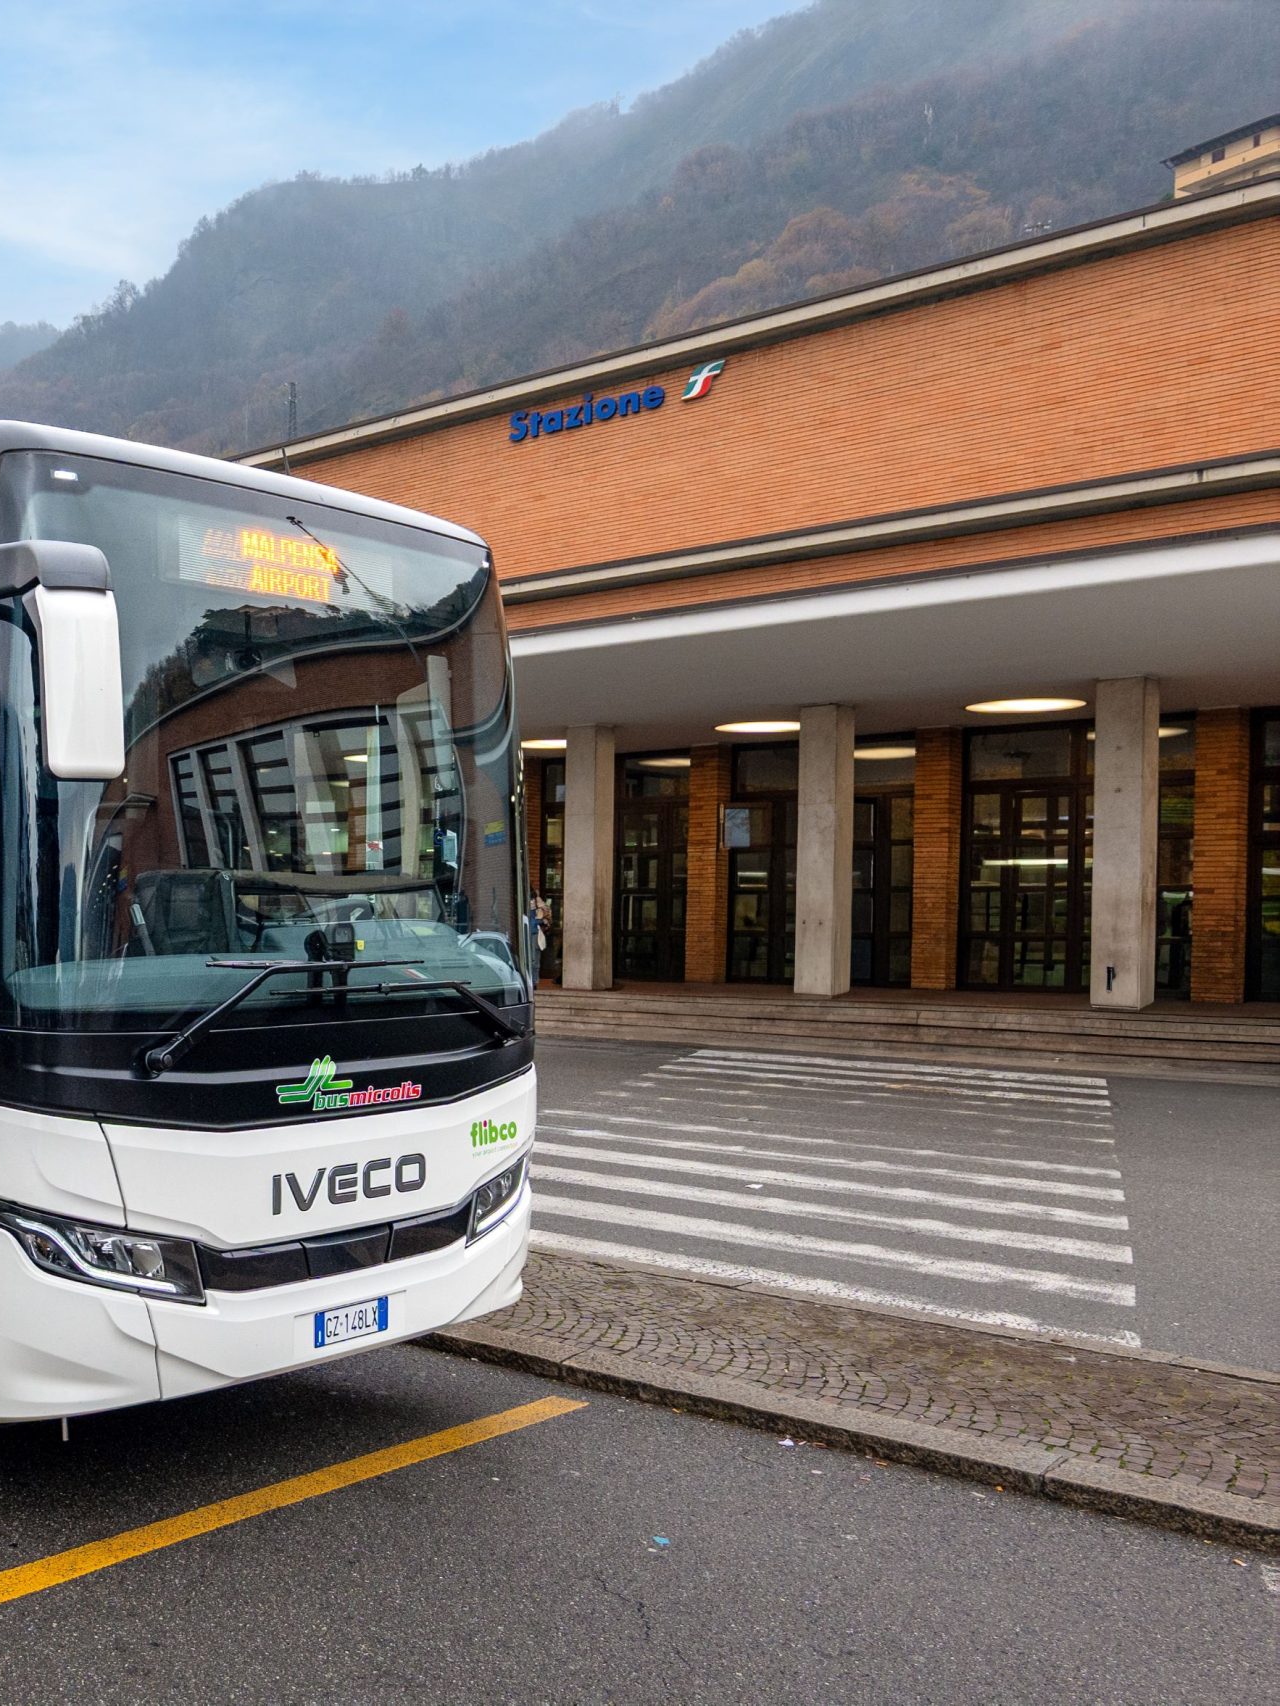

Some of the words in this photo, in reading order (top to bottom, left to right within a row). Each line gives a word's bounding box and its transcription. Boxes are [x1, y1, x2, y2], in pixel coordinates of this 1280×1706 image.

[509, 385, 665, 442] Stazione
[249, 564, 331, 602] AIRPORT
[312, 1081, 422, 1111] busmiccolis
[470, 1119, 517, 1148] flibco
[272, 1153, 426, 1215] IVECO
